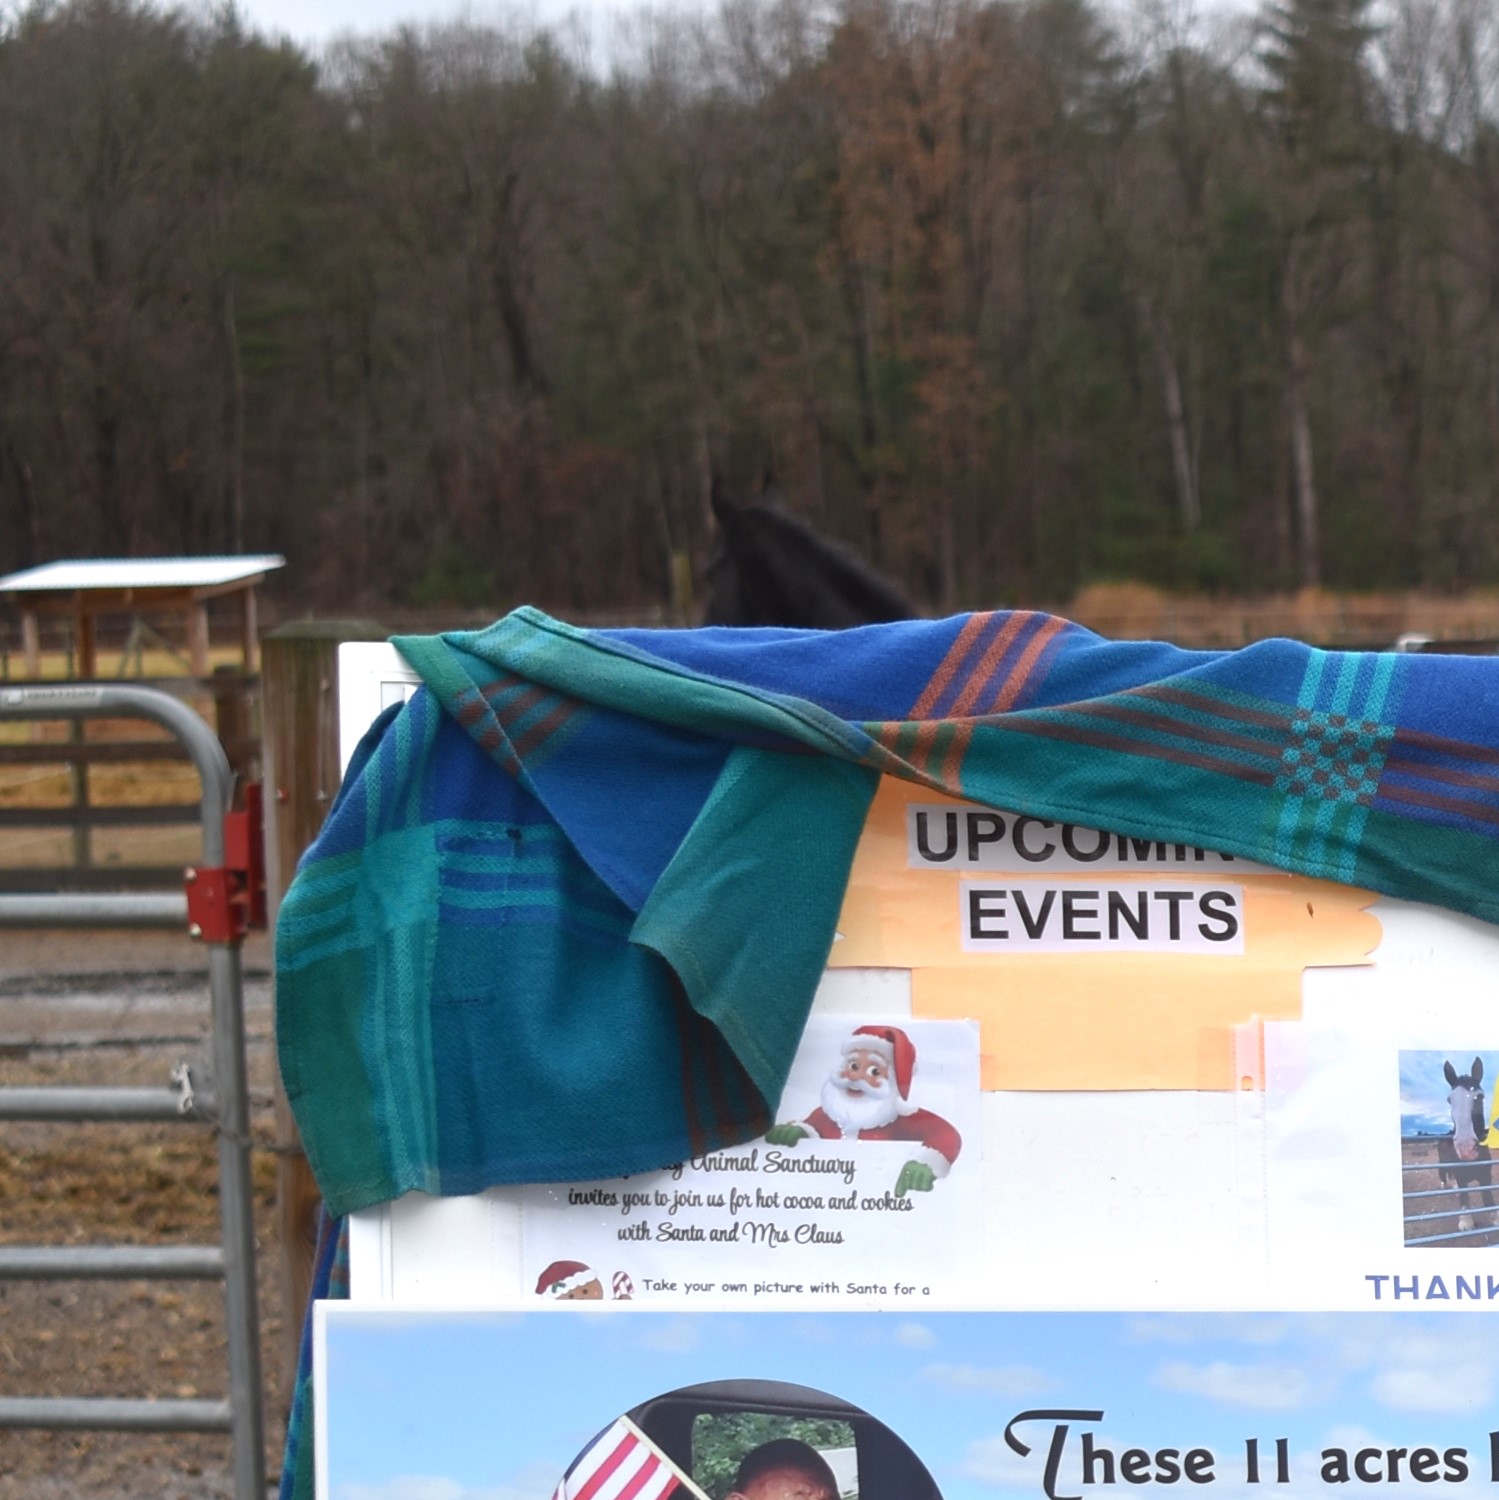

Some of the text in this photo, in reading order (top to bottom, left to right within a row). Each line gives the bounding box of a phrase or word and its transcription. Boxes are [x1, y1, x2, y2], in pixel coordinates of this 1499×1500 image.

[969, 890, 1238, 942] EVENTS
[690, 1149, 759, 1172] Animal
[763, 1151, 856, 1184] Sanctuary
[568, 1187, 914, 1215] invites you to join us for hot cocoa and cookies
[618, 1220, 844, 1248] with Santa and Mrs Claus
[643, 1279, 930, 1296] Take your own picture with Santa for a
[1247, 1439, 1288, 1482] 11
[1321, 1449, 1468, 1483] acres
